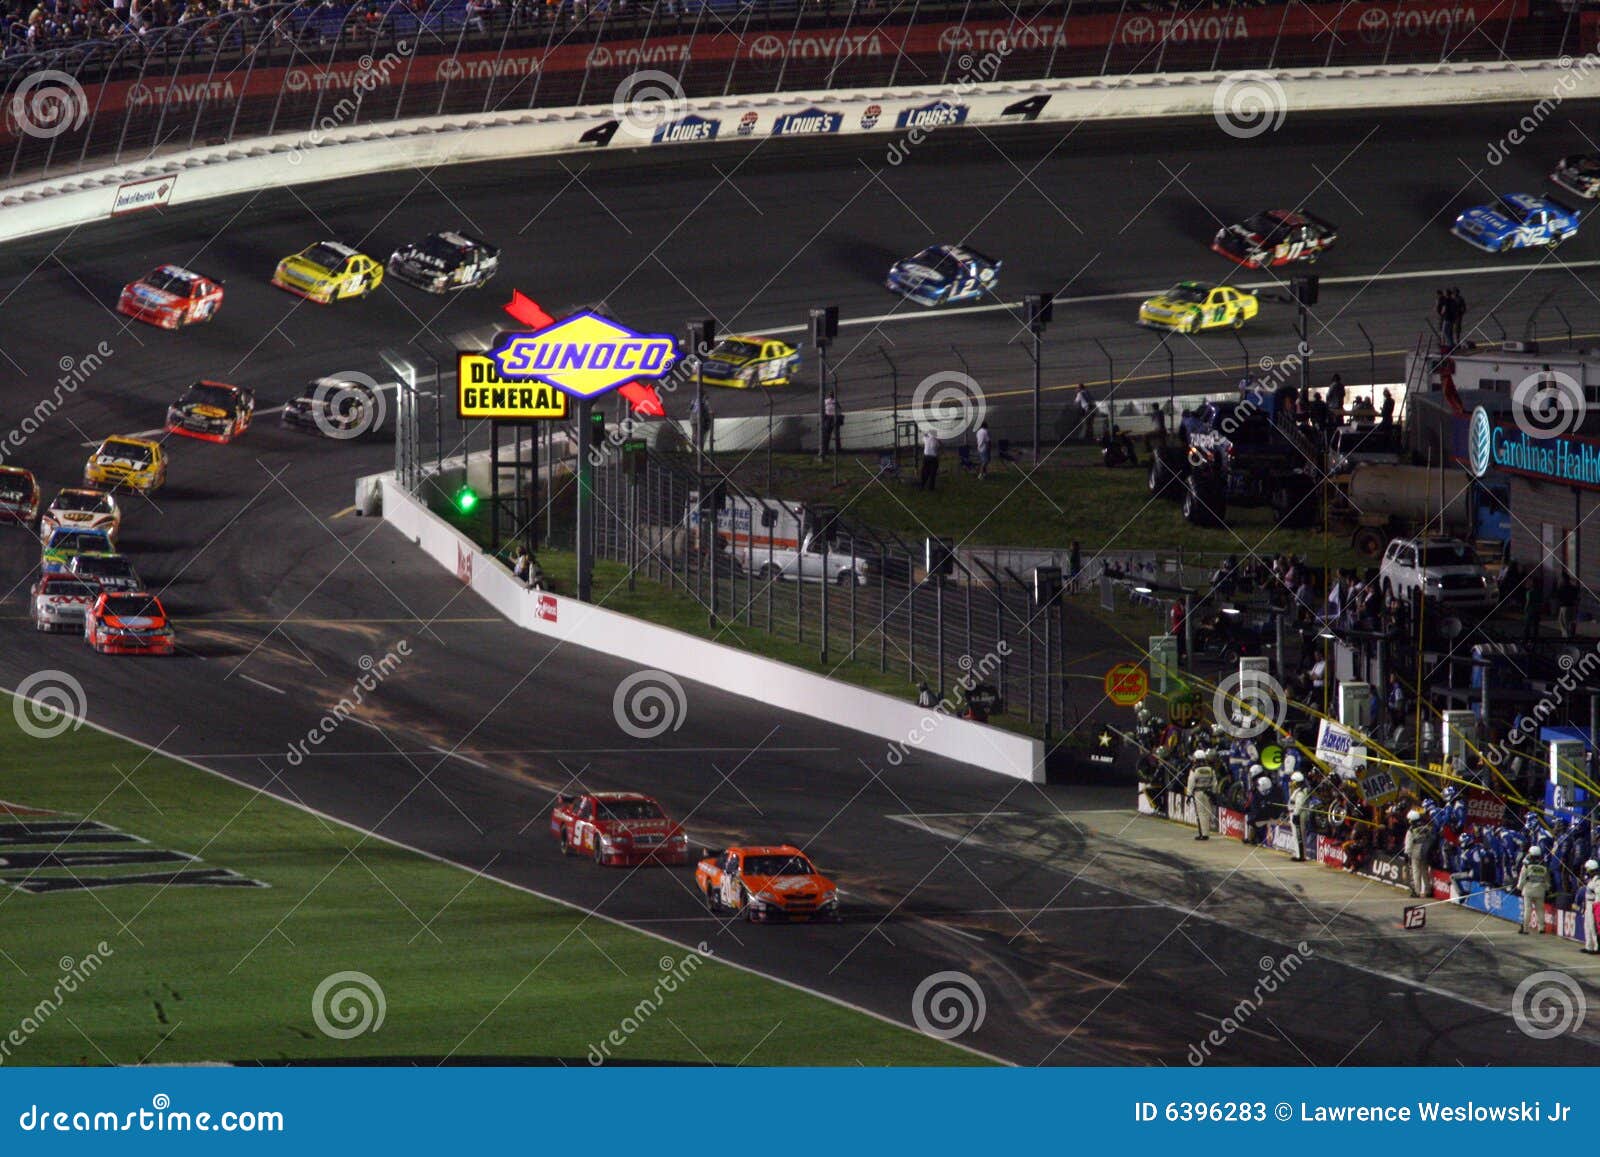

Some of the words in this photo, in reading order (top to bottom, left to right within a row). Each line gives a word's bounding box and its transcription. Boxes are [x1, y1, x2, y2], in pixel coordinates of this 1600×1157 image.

[1158, 16, 1249, 42] TOYOTA
[1393, 8, 1476, 35] TOYOTA
[788, 35, 882, 57] TOYOTA
[975, 25, 1068, 50] TOYOTA
[615, 44, 692, 65] TOYOTA
[466, 57, 543, 77] TOYOTA
[154, 81, 236, 109] TOYOTA
[906, 107, 960, 127] LOWE'S
[1001, 94, 1053, 120] 4
[578, 120, 624, 147] 4
[661, 121, 712, 142] LOWE'S
[781, 113, 832, 134] LOWE'S
[506, 342, 670, 370] SUNOCO
[463, 387, 562, 410] GENERAL
[1492, 426, 1555, 476] Carolinas
[1556, 439, 1600, 484] Health
[1372, 860, 1399, 880] UPS
[1404, 907, 1425, 928] 12
